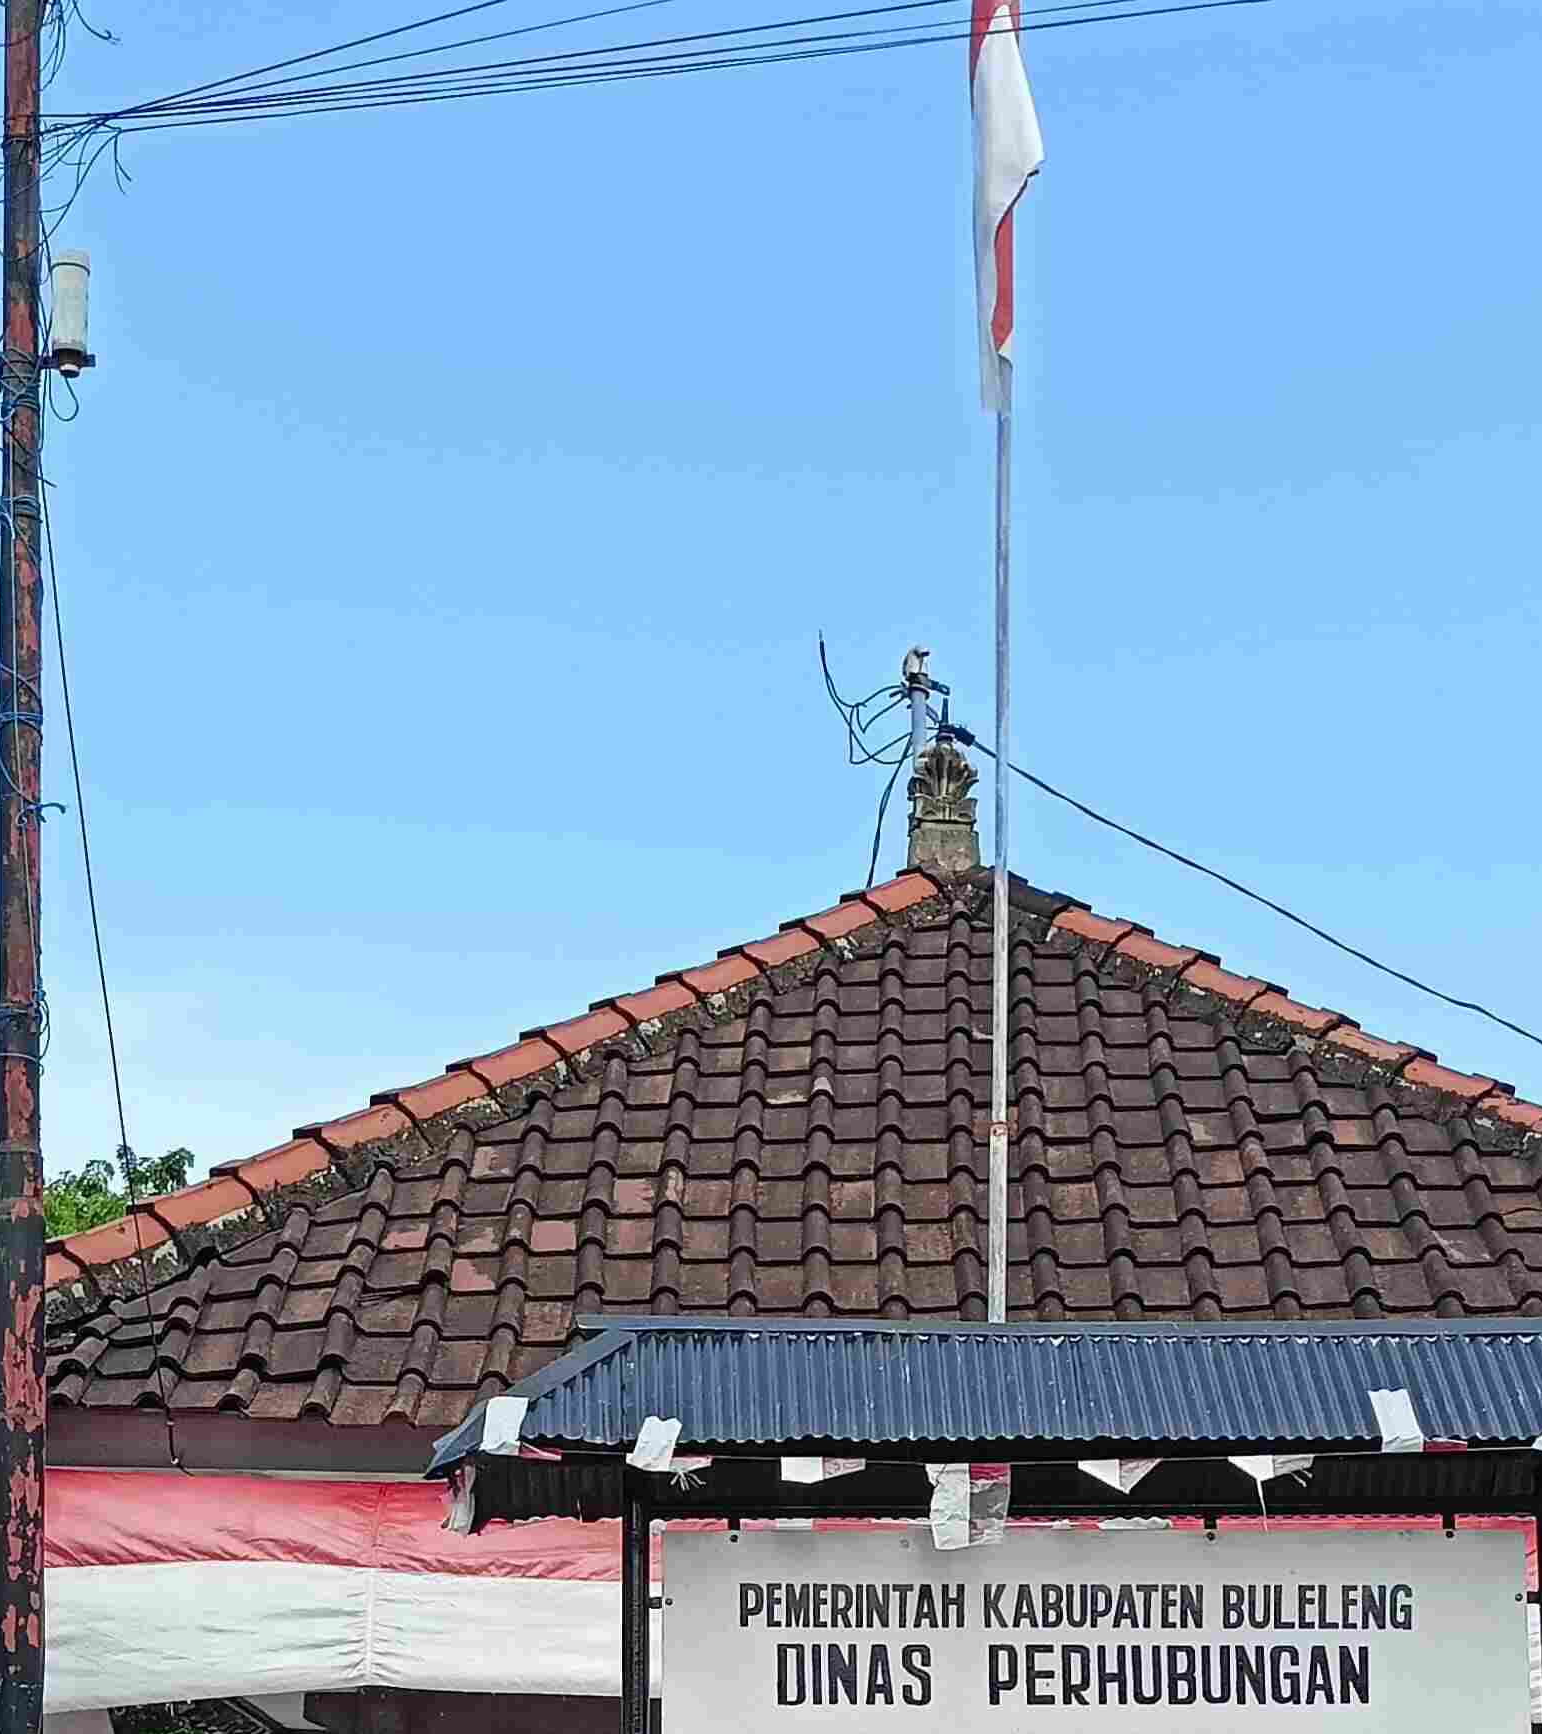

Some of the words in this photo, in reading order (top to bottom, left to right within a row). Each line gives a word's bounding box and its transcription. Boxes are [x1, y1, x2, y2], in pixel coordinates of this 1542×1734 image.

[738, 1582, 966, 1629] PEMERINTAH
[983, 1583, 1204, 1630] KABUPATEN
[1222, 1583, 1413, 1631] BULELENG
[776, 1643, 932, 1706] DINAS
[988, 1643, 1370, 1706] PERHUBUNGAN
